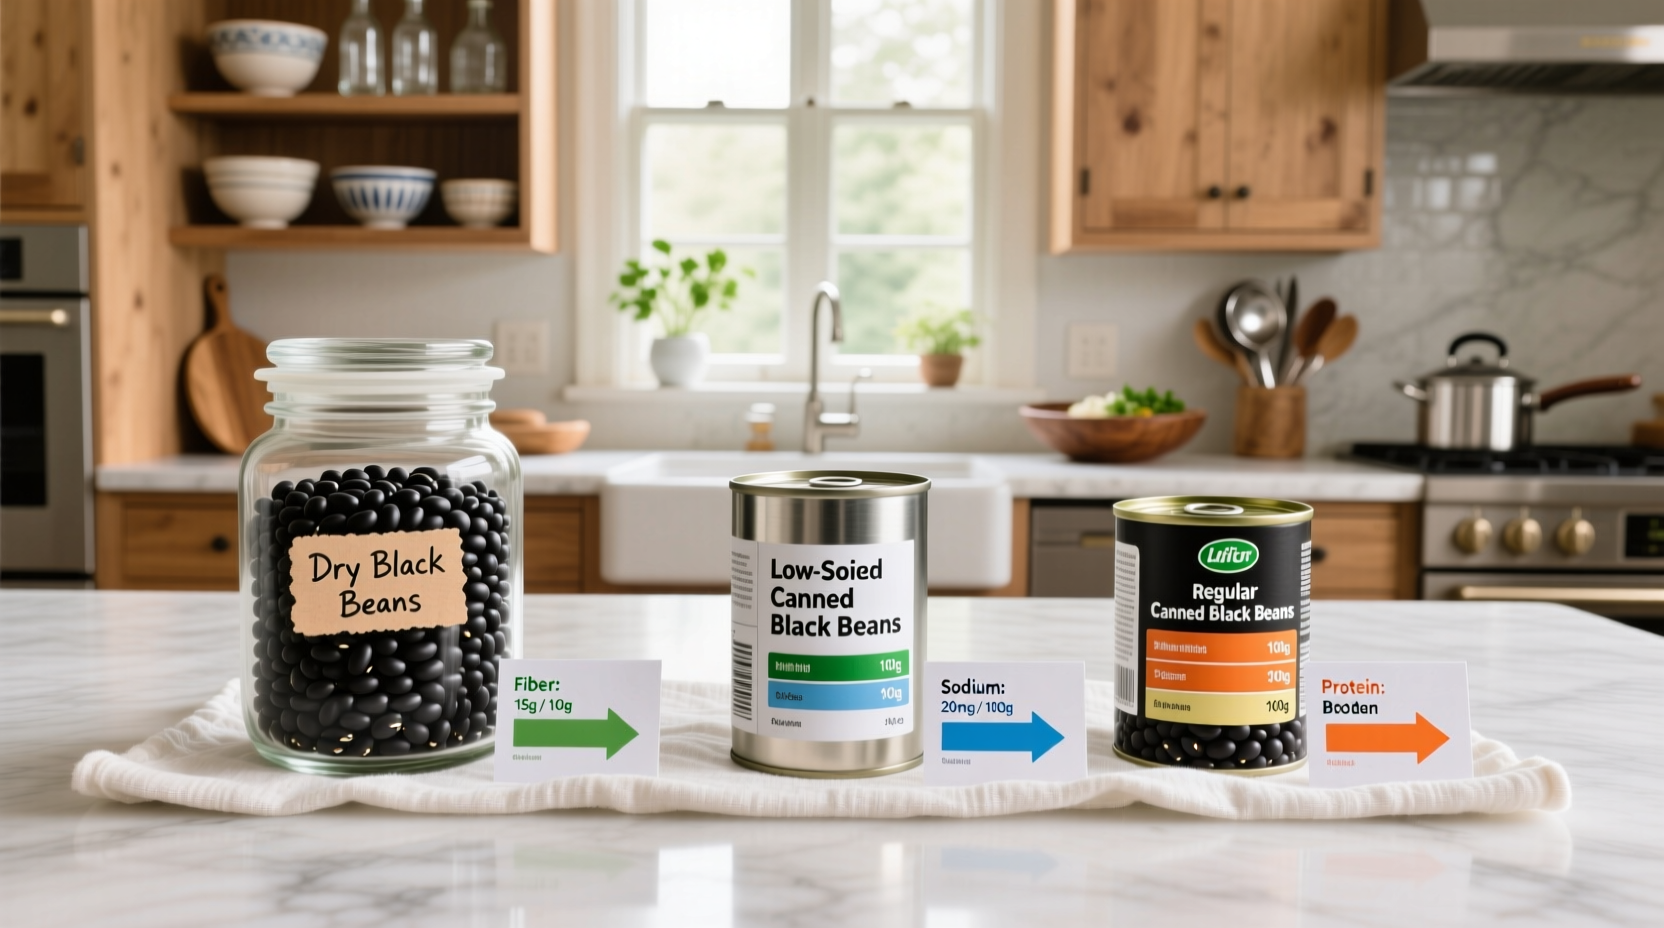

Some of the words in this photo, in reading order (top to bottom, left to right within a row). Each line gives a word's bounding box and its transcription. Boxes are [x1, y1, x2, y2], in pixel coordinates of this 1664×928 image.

[308, 552, 361, 588] Dry
[370, 545, 445, 579] Black
[770, 558, 883, 581] Low-Soied
[770, 586, 854, 609] Canned
[1192, 582, 1259, 604] Regular
[338, 590, 422, 618] Beans
[1150, 601, 1205, 621] Canned
[1209, 605, 1251, 622] Black
[1254, 604, 1295, 621] Beans
[770, 613, 832, 637] Black
[837, 616, 902, 637] Beans
[514, 675, 560, 692] Fiber:
[941, 677, 1006, 695] Sodium:
[1321, 678, 1386, 695] Protein:
[514, 698, 537, 714] 15g
[549, 698, 573, 714] 10g
[985, 701, 1014, 716] 100g
